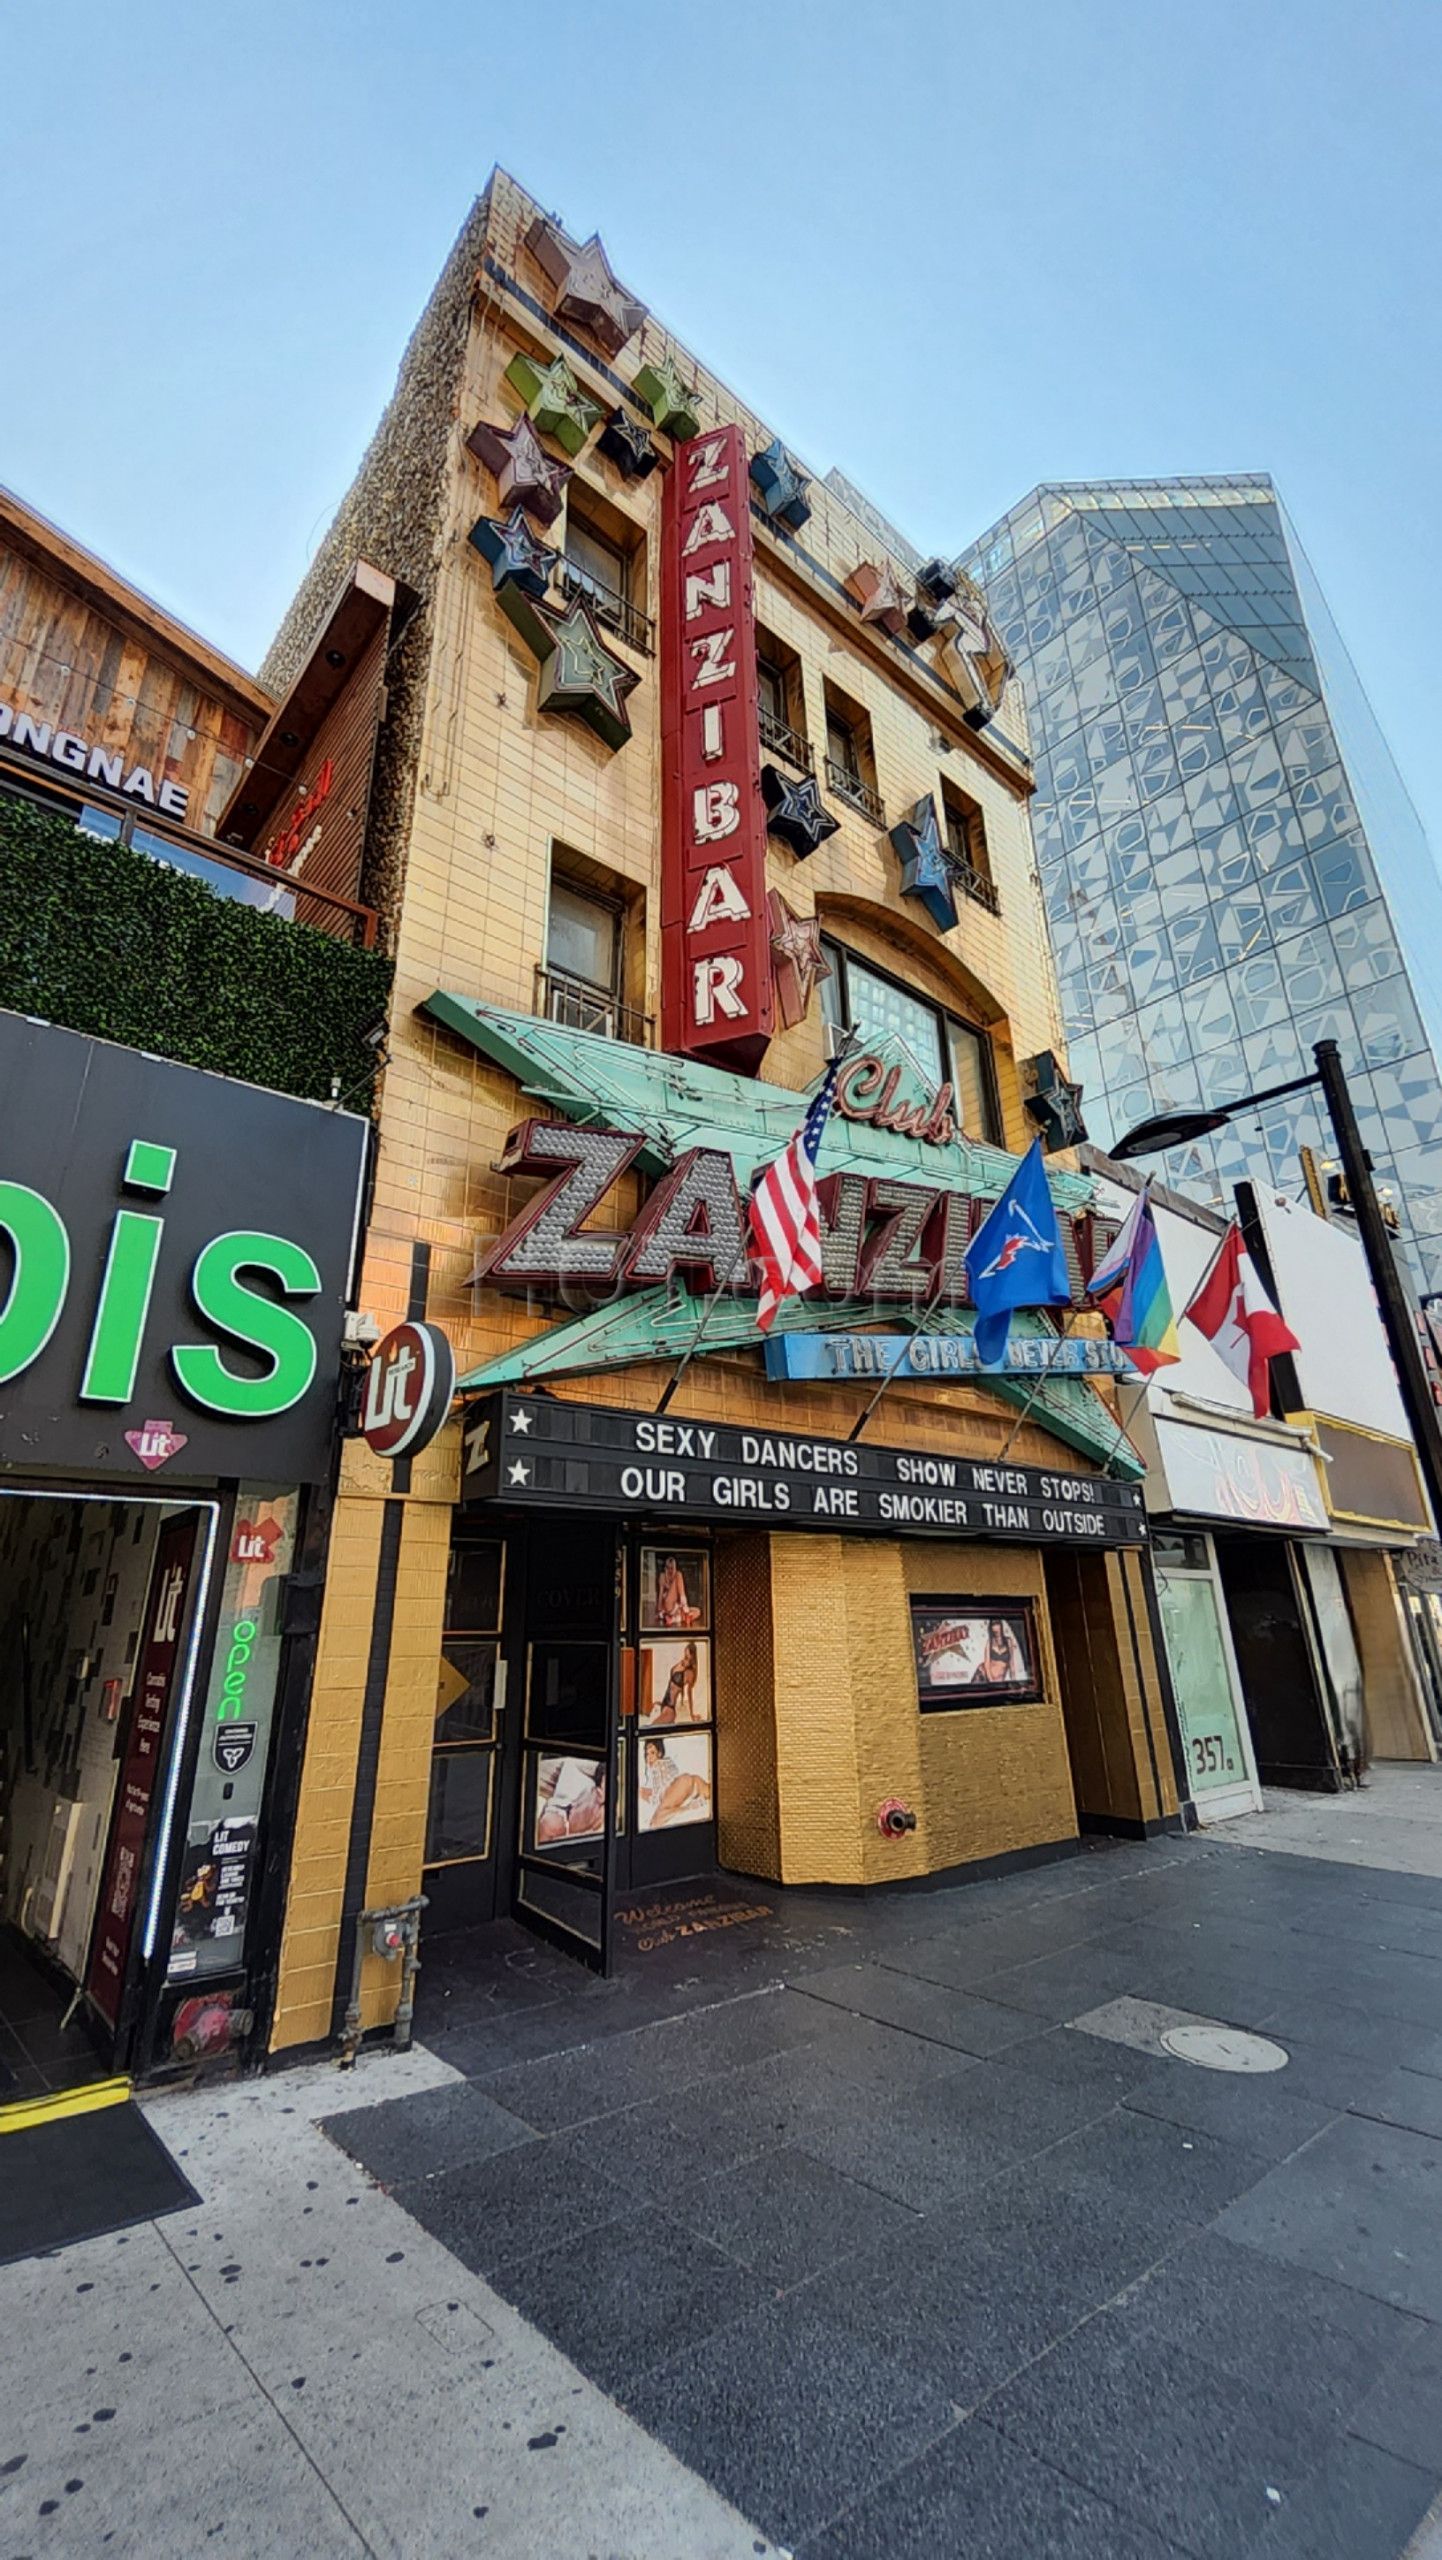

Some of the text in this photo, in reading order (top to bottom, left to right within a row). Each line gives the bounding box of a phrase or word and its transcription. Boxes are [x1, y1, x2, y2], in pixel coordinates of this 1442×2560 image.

[682, 435, 752, 1027] ZANZIBAR
[836, 1054, 955, 1145] Club
[826, 1339, 892, 1371] THE
[1008, 1340, 1079, 1368] NEVER
[364, 1346, 416, 1432] Lit
[139, 1429, 172, 1459] Lit
[464, 1420, 490, 1476] Z
[636, 1421, 1095, 1504] SEXY DANCERS SHOW NEVER STOPS!
[620, 1467, 1106, 1536] OUR GIRLS ARE SMOKIER THAN OUTSIDE
[238, 1533, 265, 1559] Lit
[217, 1619, 256, 1721] open
[212, 1840, 251, 1856] COMEDY
[214, 1830, 230, 1843] LIT
[614, 1894, 717, 1925] Welcome
[675, 1904, 774, 1936] ZANZIBAR
